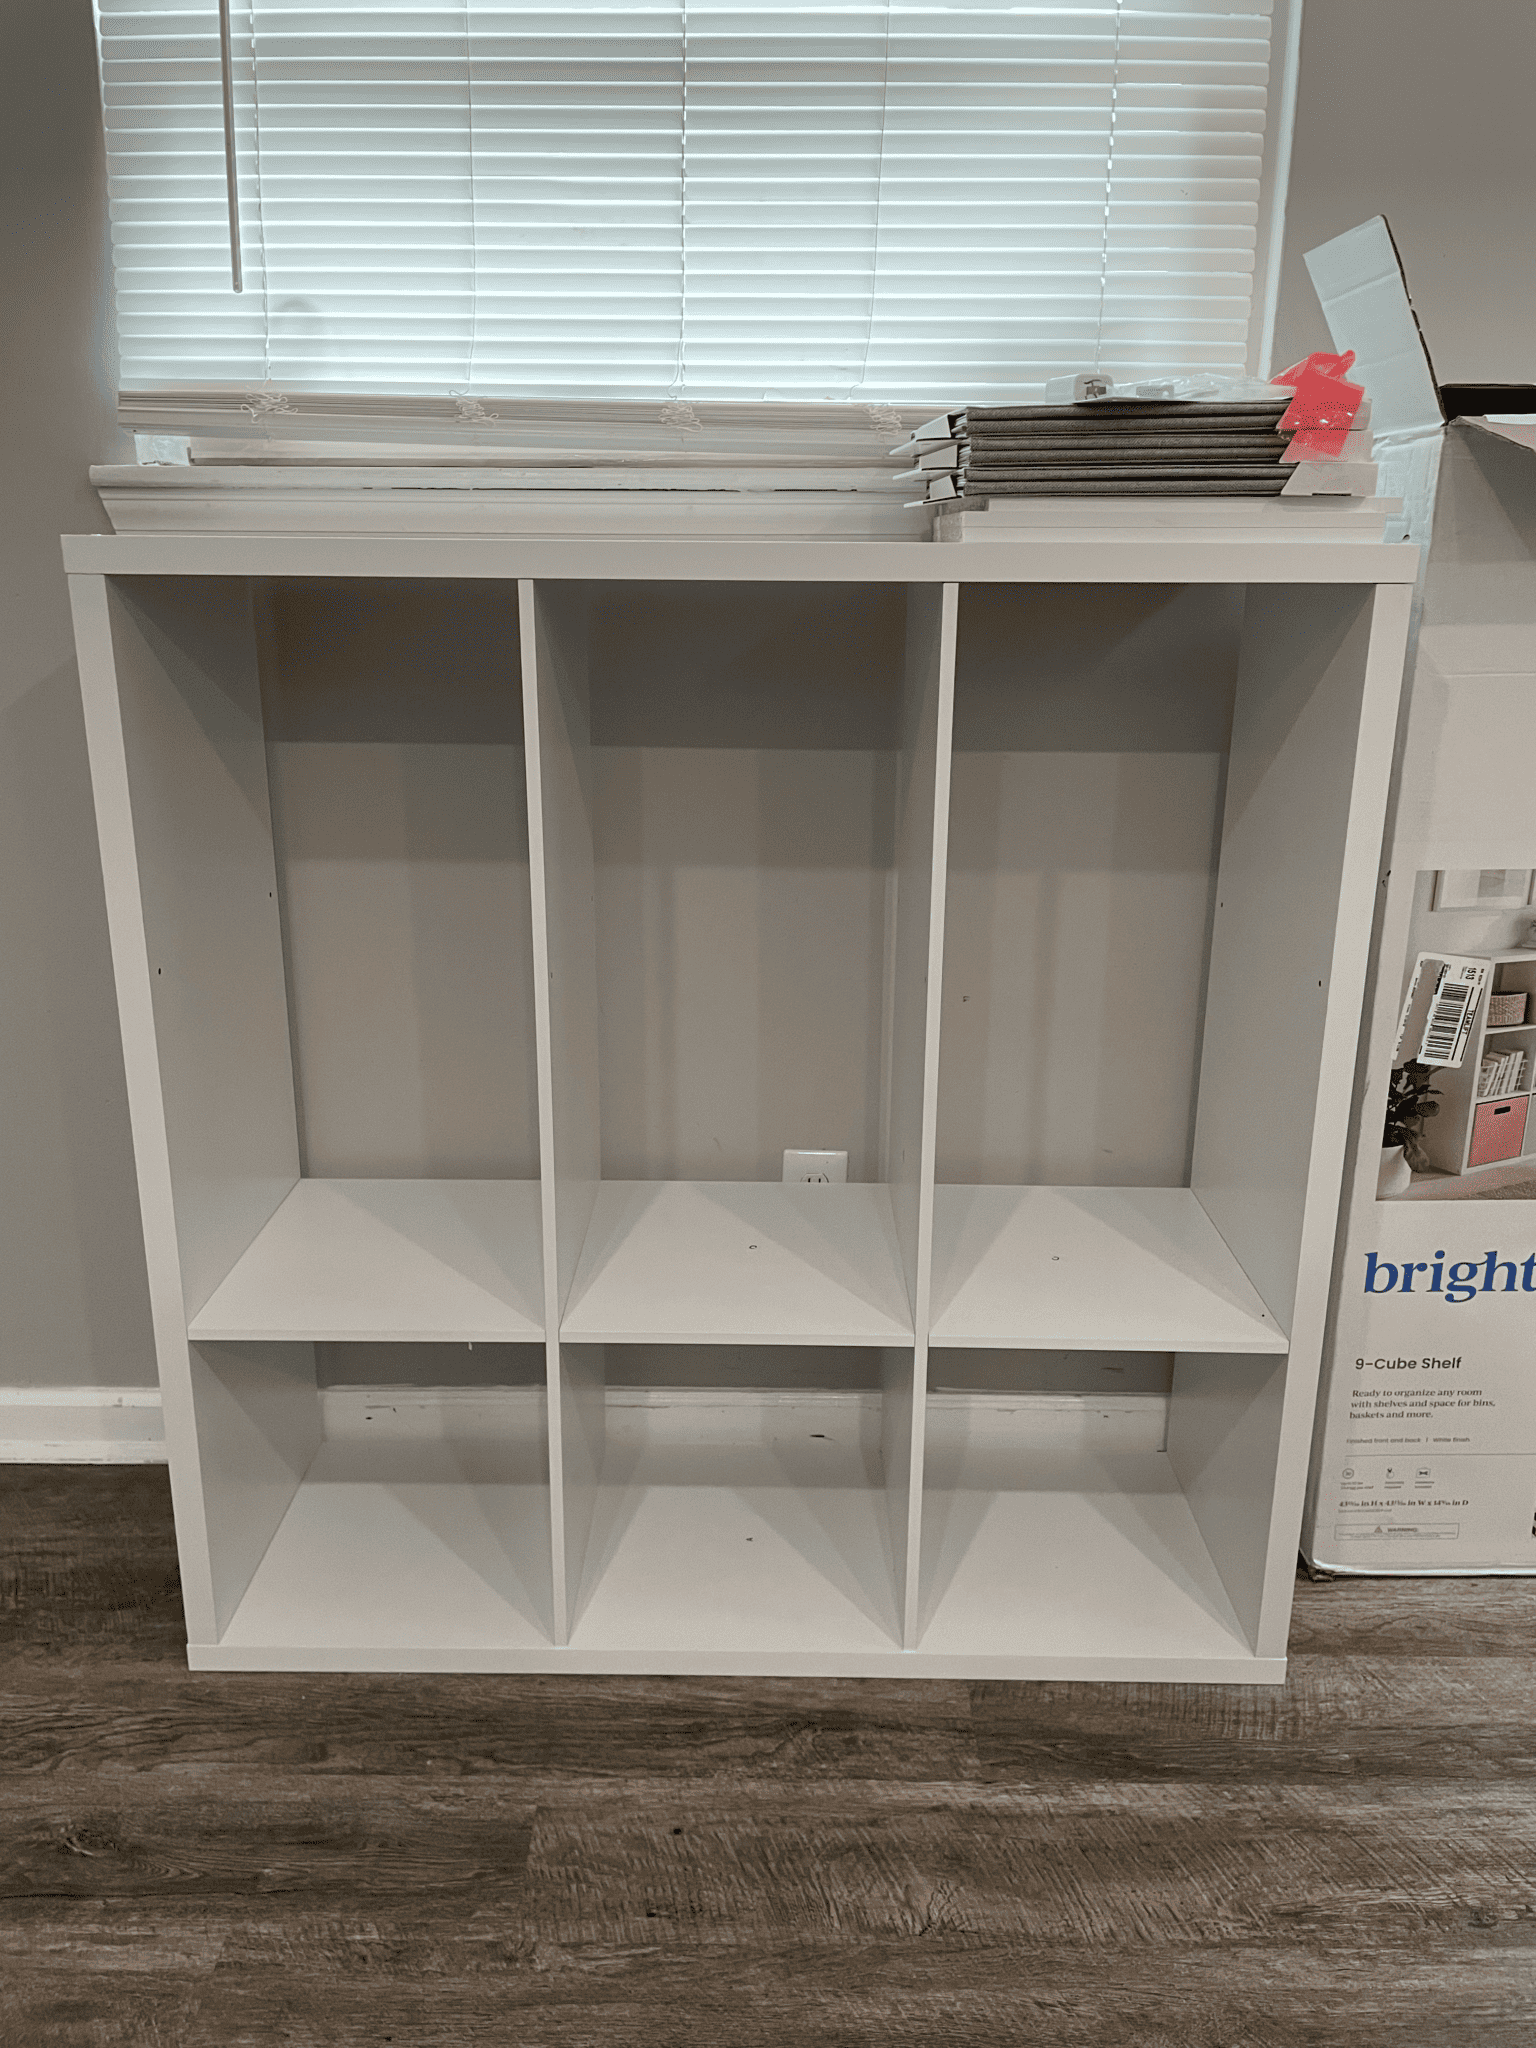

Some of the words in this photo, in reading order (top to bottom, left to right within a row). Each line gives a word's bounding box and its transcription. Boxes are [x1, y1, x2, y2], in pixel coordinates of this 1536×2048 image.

[1355, 1357, 1417, 1370] 9-Cube
[1421, 1356, 1462, 1370] Shelf
[1352, 1389, 1381, 1399] Ready
[1383, 1389, 1393, 1397] to
[1394, 1389, 1436, 1398] organize
[1437, 1390, 1454, 1398] any
[1457, 1389, 1482, 1397] room
[1351, 1400, 1372, 1408] with
[1373, 1400, 1408, 1408] shelves
[1409, 1399, 1428, 1407] and
[1429, 1400, 1455, 1409] space
[1457, 1399, 1471, 1407] for
[1473, 1399, 1496, 1407] bins,
[1349, 1411, 1384, 1420] baskets
[1386, 1410, 1404, 1419] and
